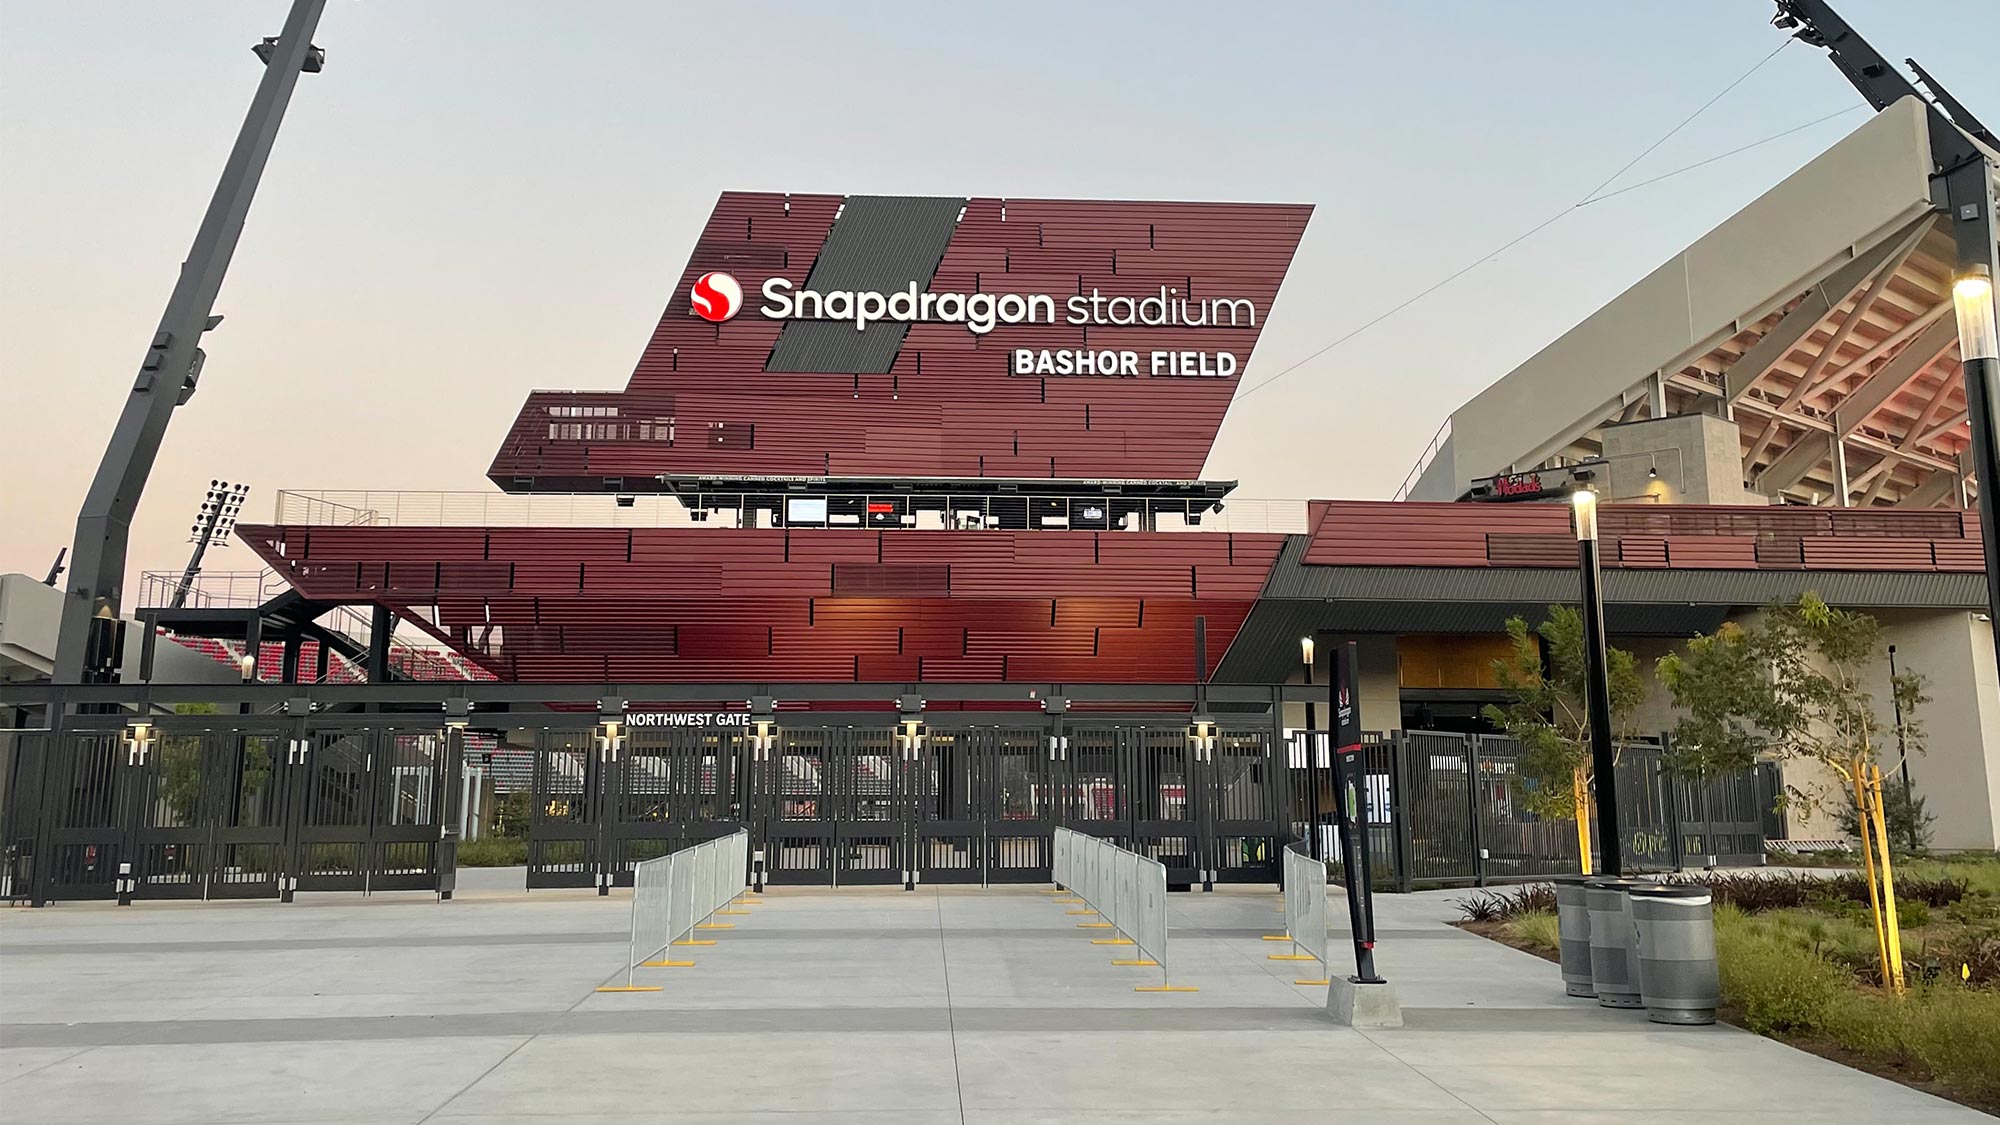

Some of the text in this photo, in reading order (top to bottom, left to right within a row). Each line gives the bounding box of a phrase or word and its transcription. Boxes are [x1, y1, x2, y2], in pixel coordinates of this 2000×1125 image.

[760, 277, 1256, 334] Snapdragon stadium
[1015, 349, 1238, 377] BASHOR FIELD
[625, 713, 750, 726] NORTHWEST GATE
